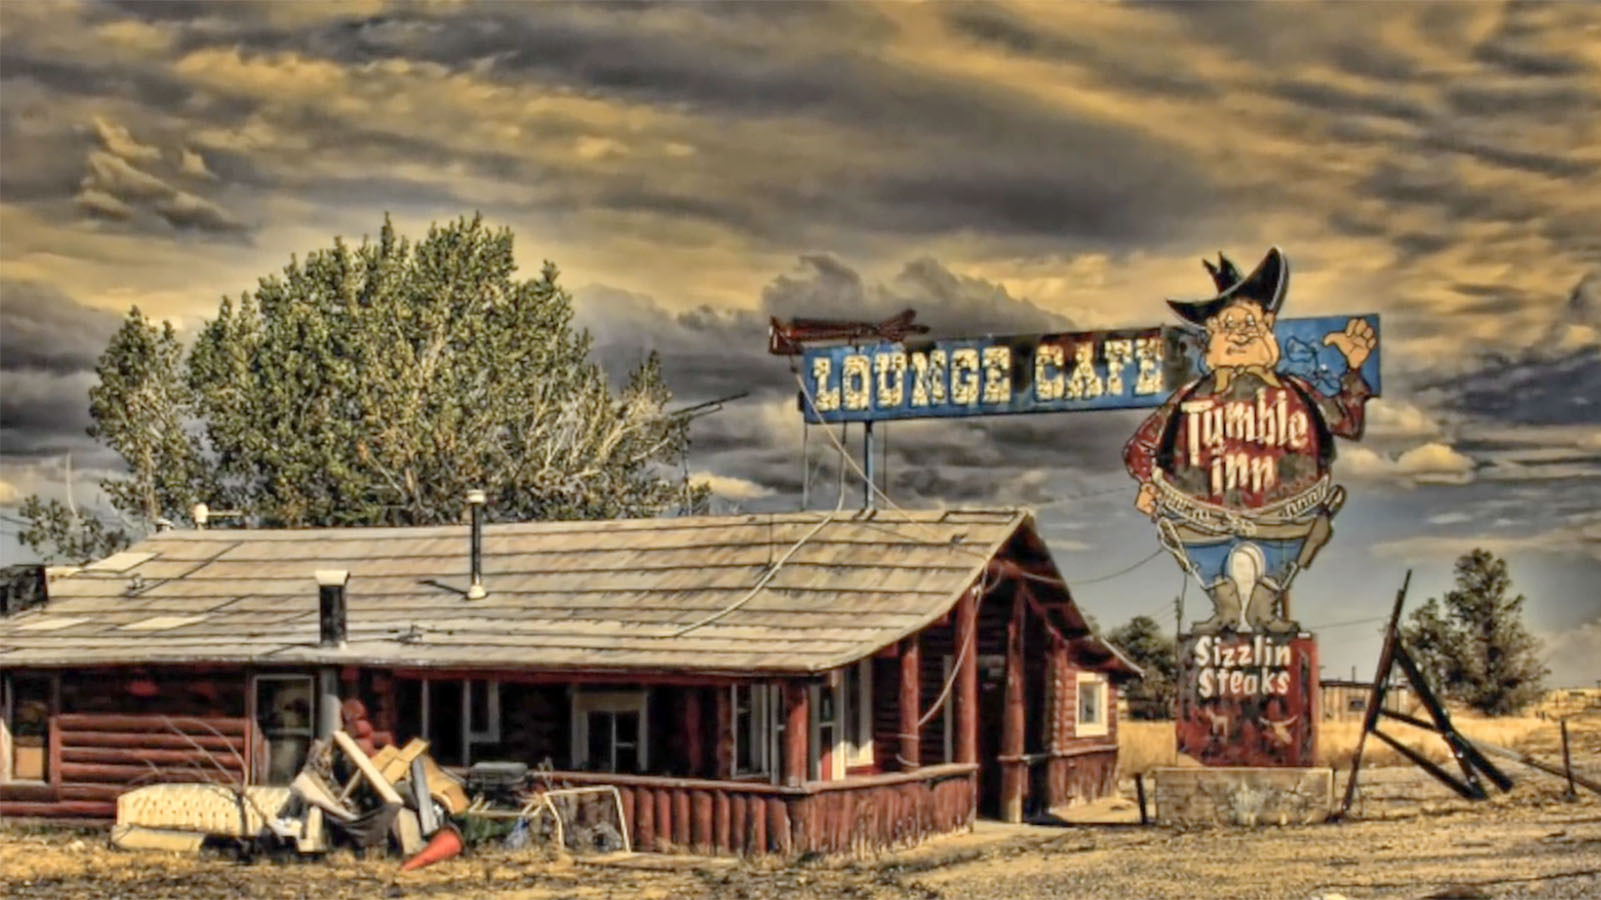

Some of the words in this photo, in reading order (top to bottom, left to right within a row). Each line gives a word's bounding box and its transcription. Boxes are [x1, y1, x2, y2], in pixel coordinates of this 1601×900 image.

[813, 346, 1011, 411] LOUNGE
[1034, 336, 1164, 401] CAFE
[1181, 387, 1309, 466] Tumble
[1211, 443, 1275, 496] inn
[1195, 634, 1291, 667] Sizzlin
[1199, 667, 1291, 697] Steaks
